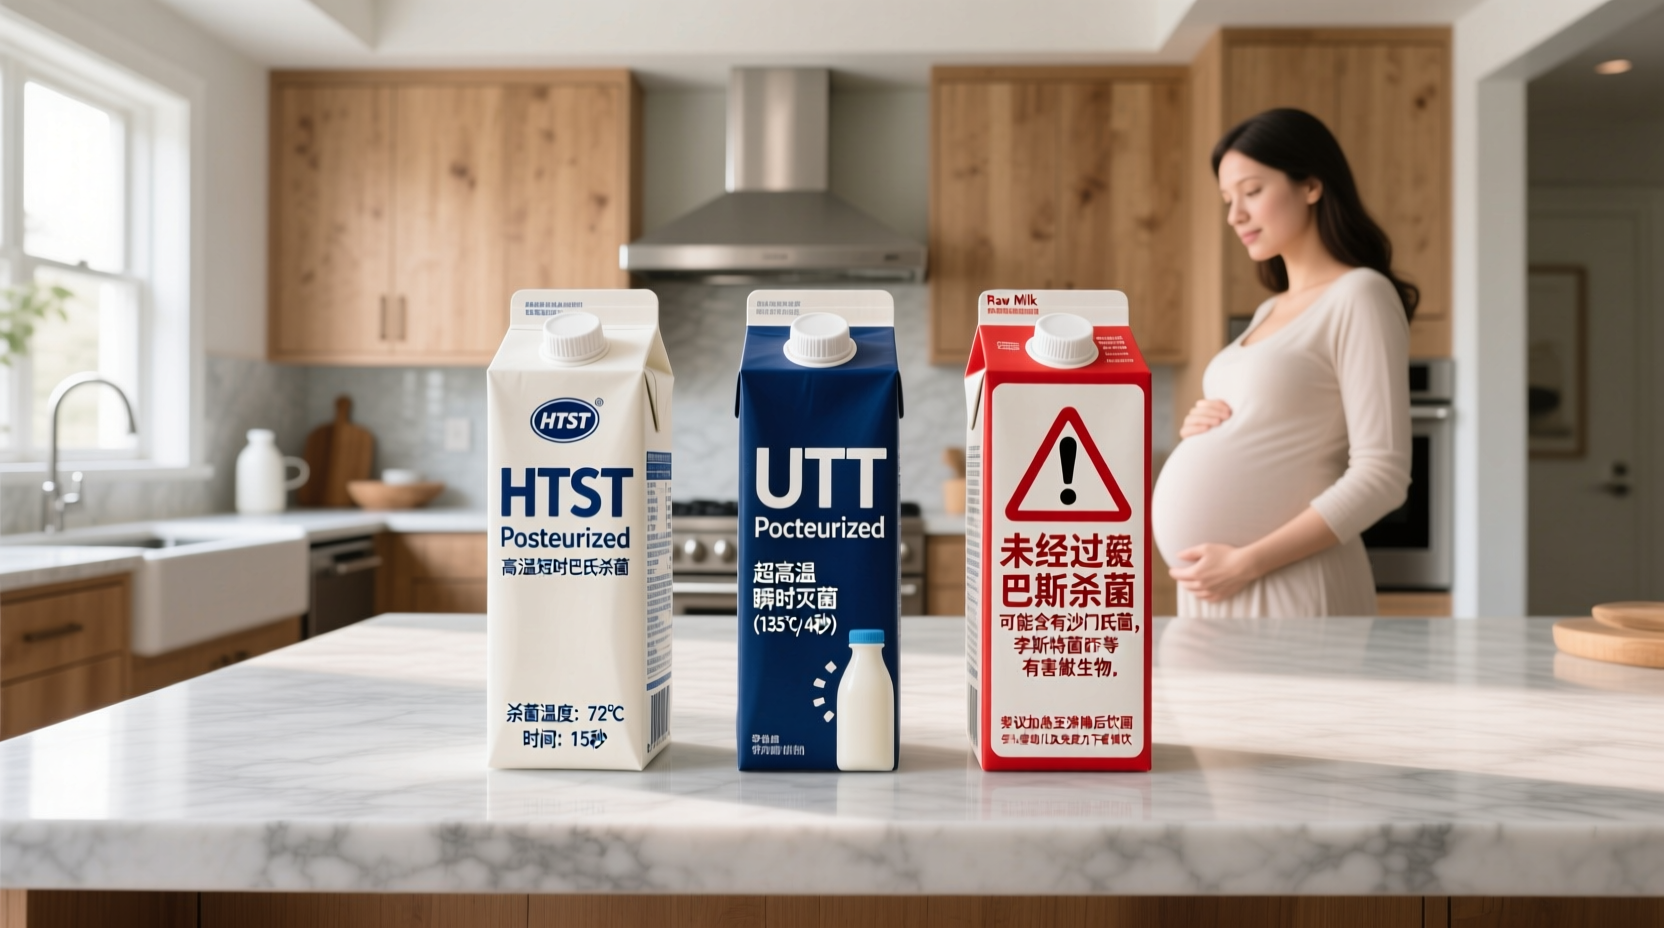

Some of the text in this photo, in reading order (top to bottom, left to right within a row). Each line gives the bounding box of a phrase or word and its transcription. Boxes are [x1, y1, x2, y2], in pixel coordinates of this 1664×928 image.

[1014, 294, 1038, 306] Milk
[540, 412, 592, 429] HTST
[756, 447, 887, 509] UTT
[501, 467, 634, 518] HTST
[501, 526, 630, 549] Posteurized
[755, 515, 885, 539] Pocteurized
[753, 560, 816, 584] 超高温
[1002, 572, 1135, 608] 巴斯杀菌
